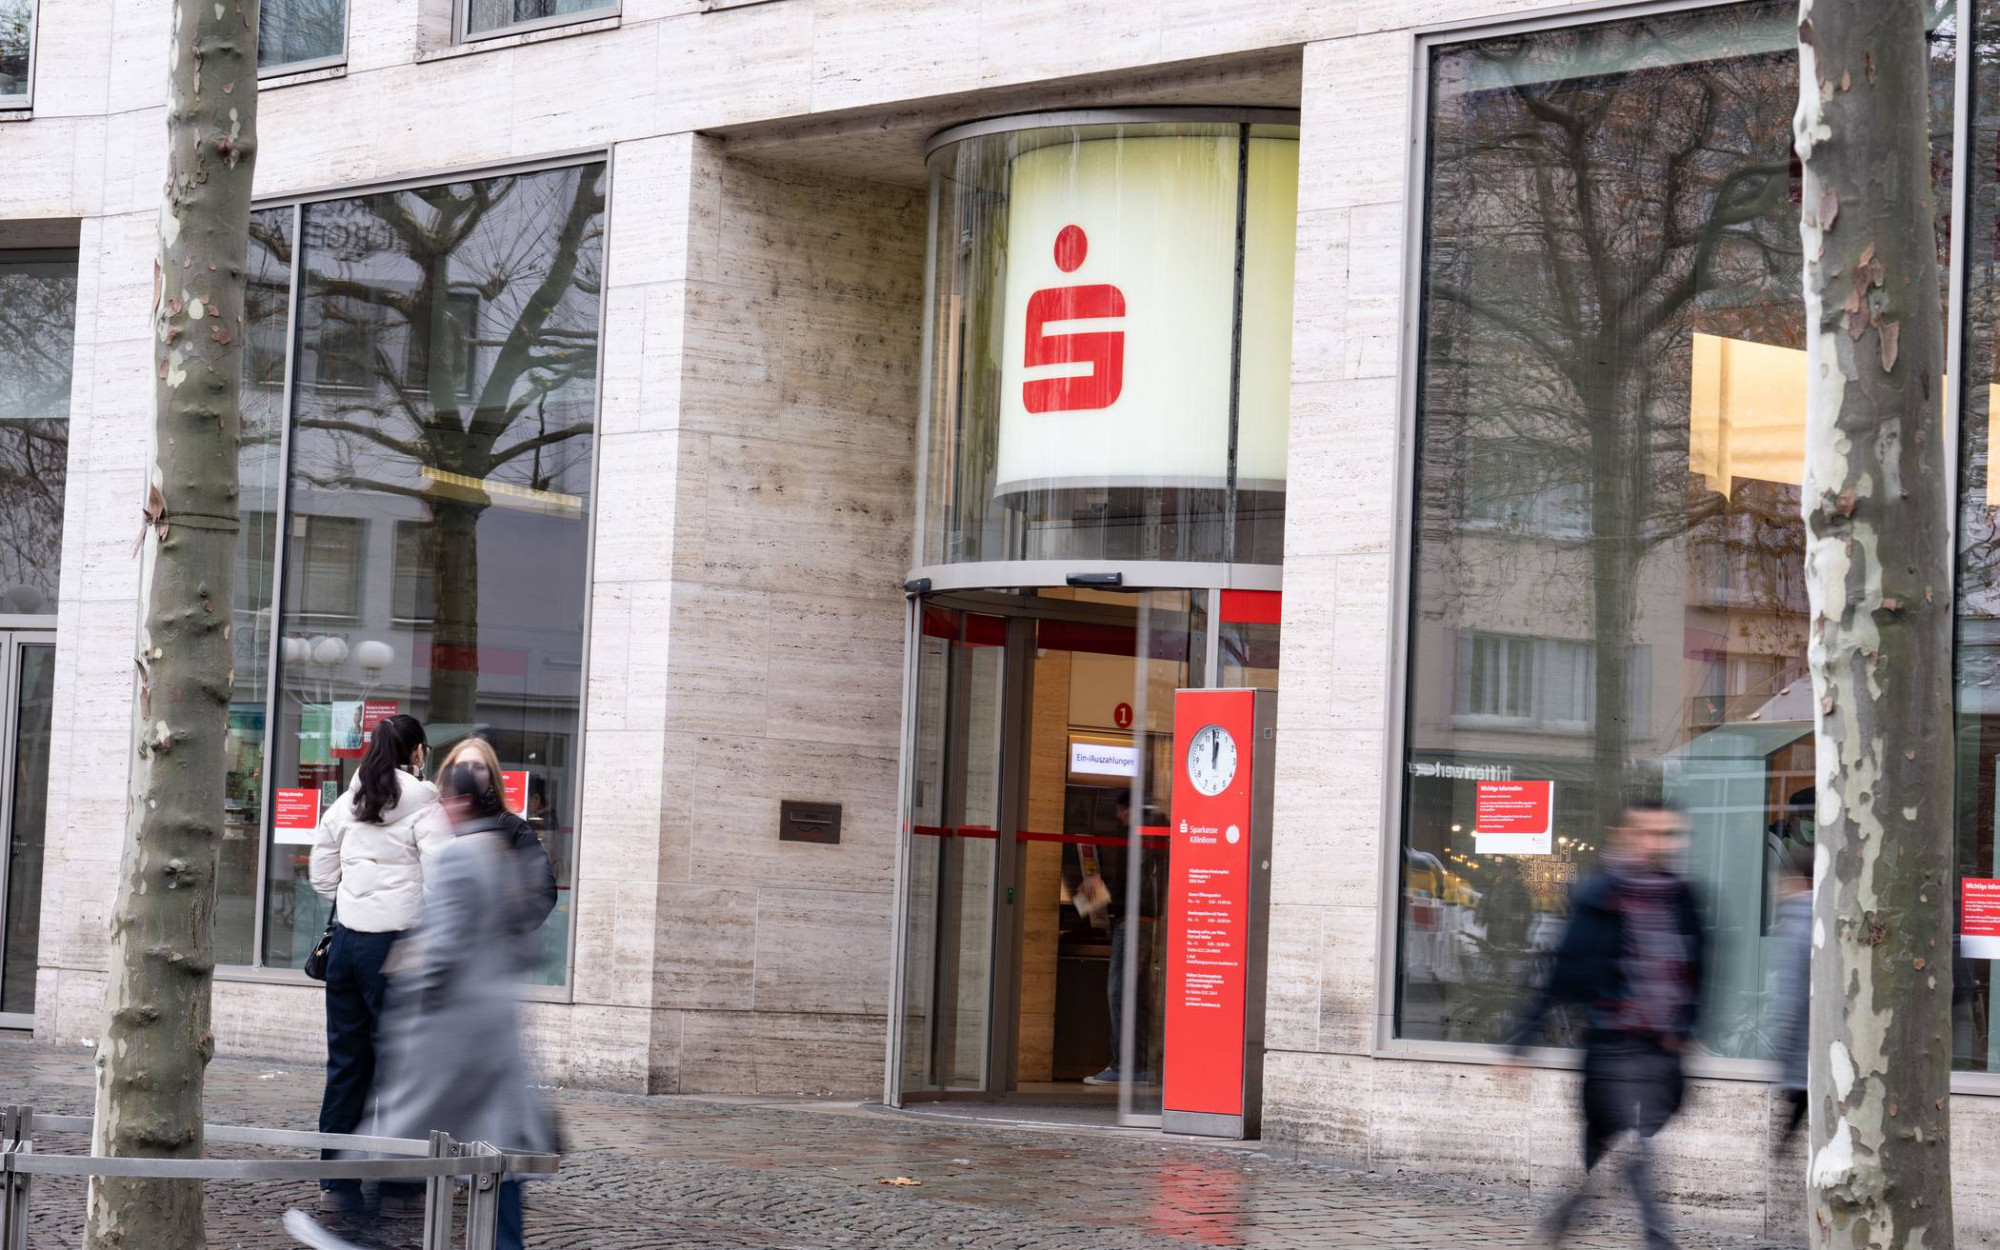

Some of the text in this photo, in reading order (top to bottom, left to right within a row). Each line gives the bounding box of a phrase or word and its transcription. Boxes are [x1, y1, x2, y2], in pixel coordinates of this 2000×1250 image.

[1119, 707, 1128, 724] 1
[1190, 826, 1218, 834] Sparkasse
[1190, 836, 1217, 844] KölnBonn
